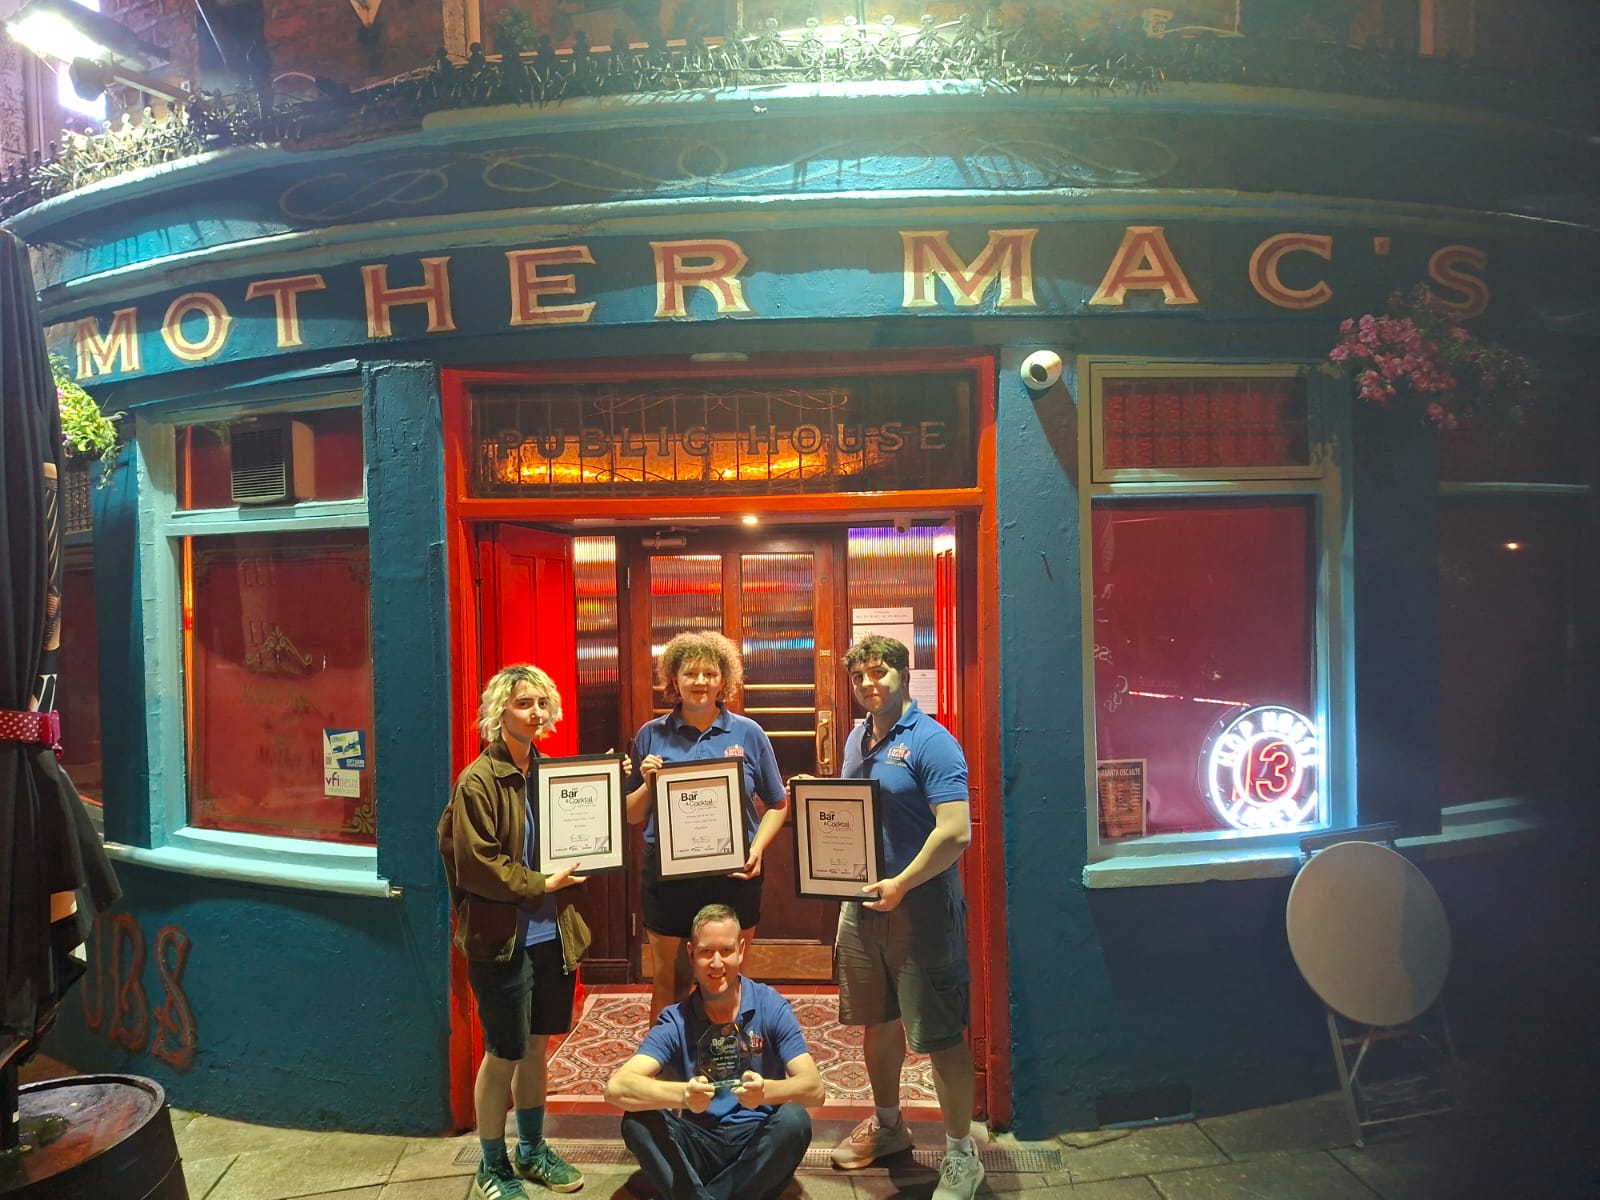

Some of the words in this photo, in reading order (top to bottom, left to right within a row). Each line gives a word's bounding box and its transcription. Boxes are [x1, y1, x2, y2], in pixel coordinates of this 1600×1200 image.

[75, 239, 750, 380] MOTHER
[899, 226, 1489, 319] MAC'S
[497, 425, 710, 459] PUBLIC
[748, 421, 948, 456] HOUSE
[325, 771, 340, 787] vfi
[561, 789, 578, 799] Bar
[681, 792, 698, 802] Bar
[820, 811, 835, 821] Bar
